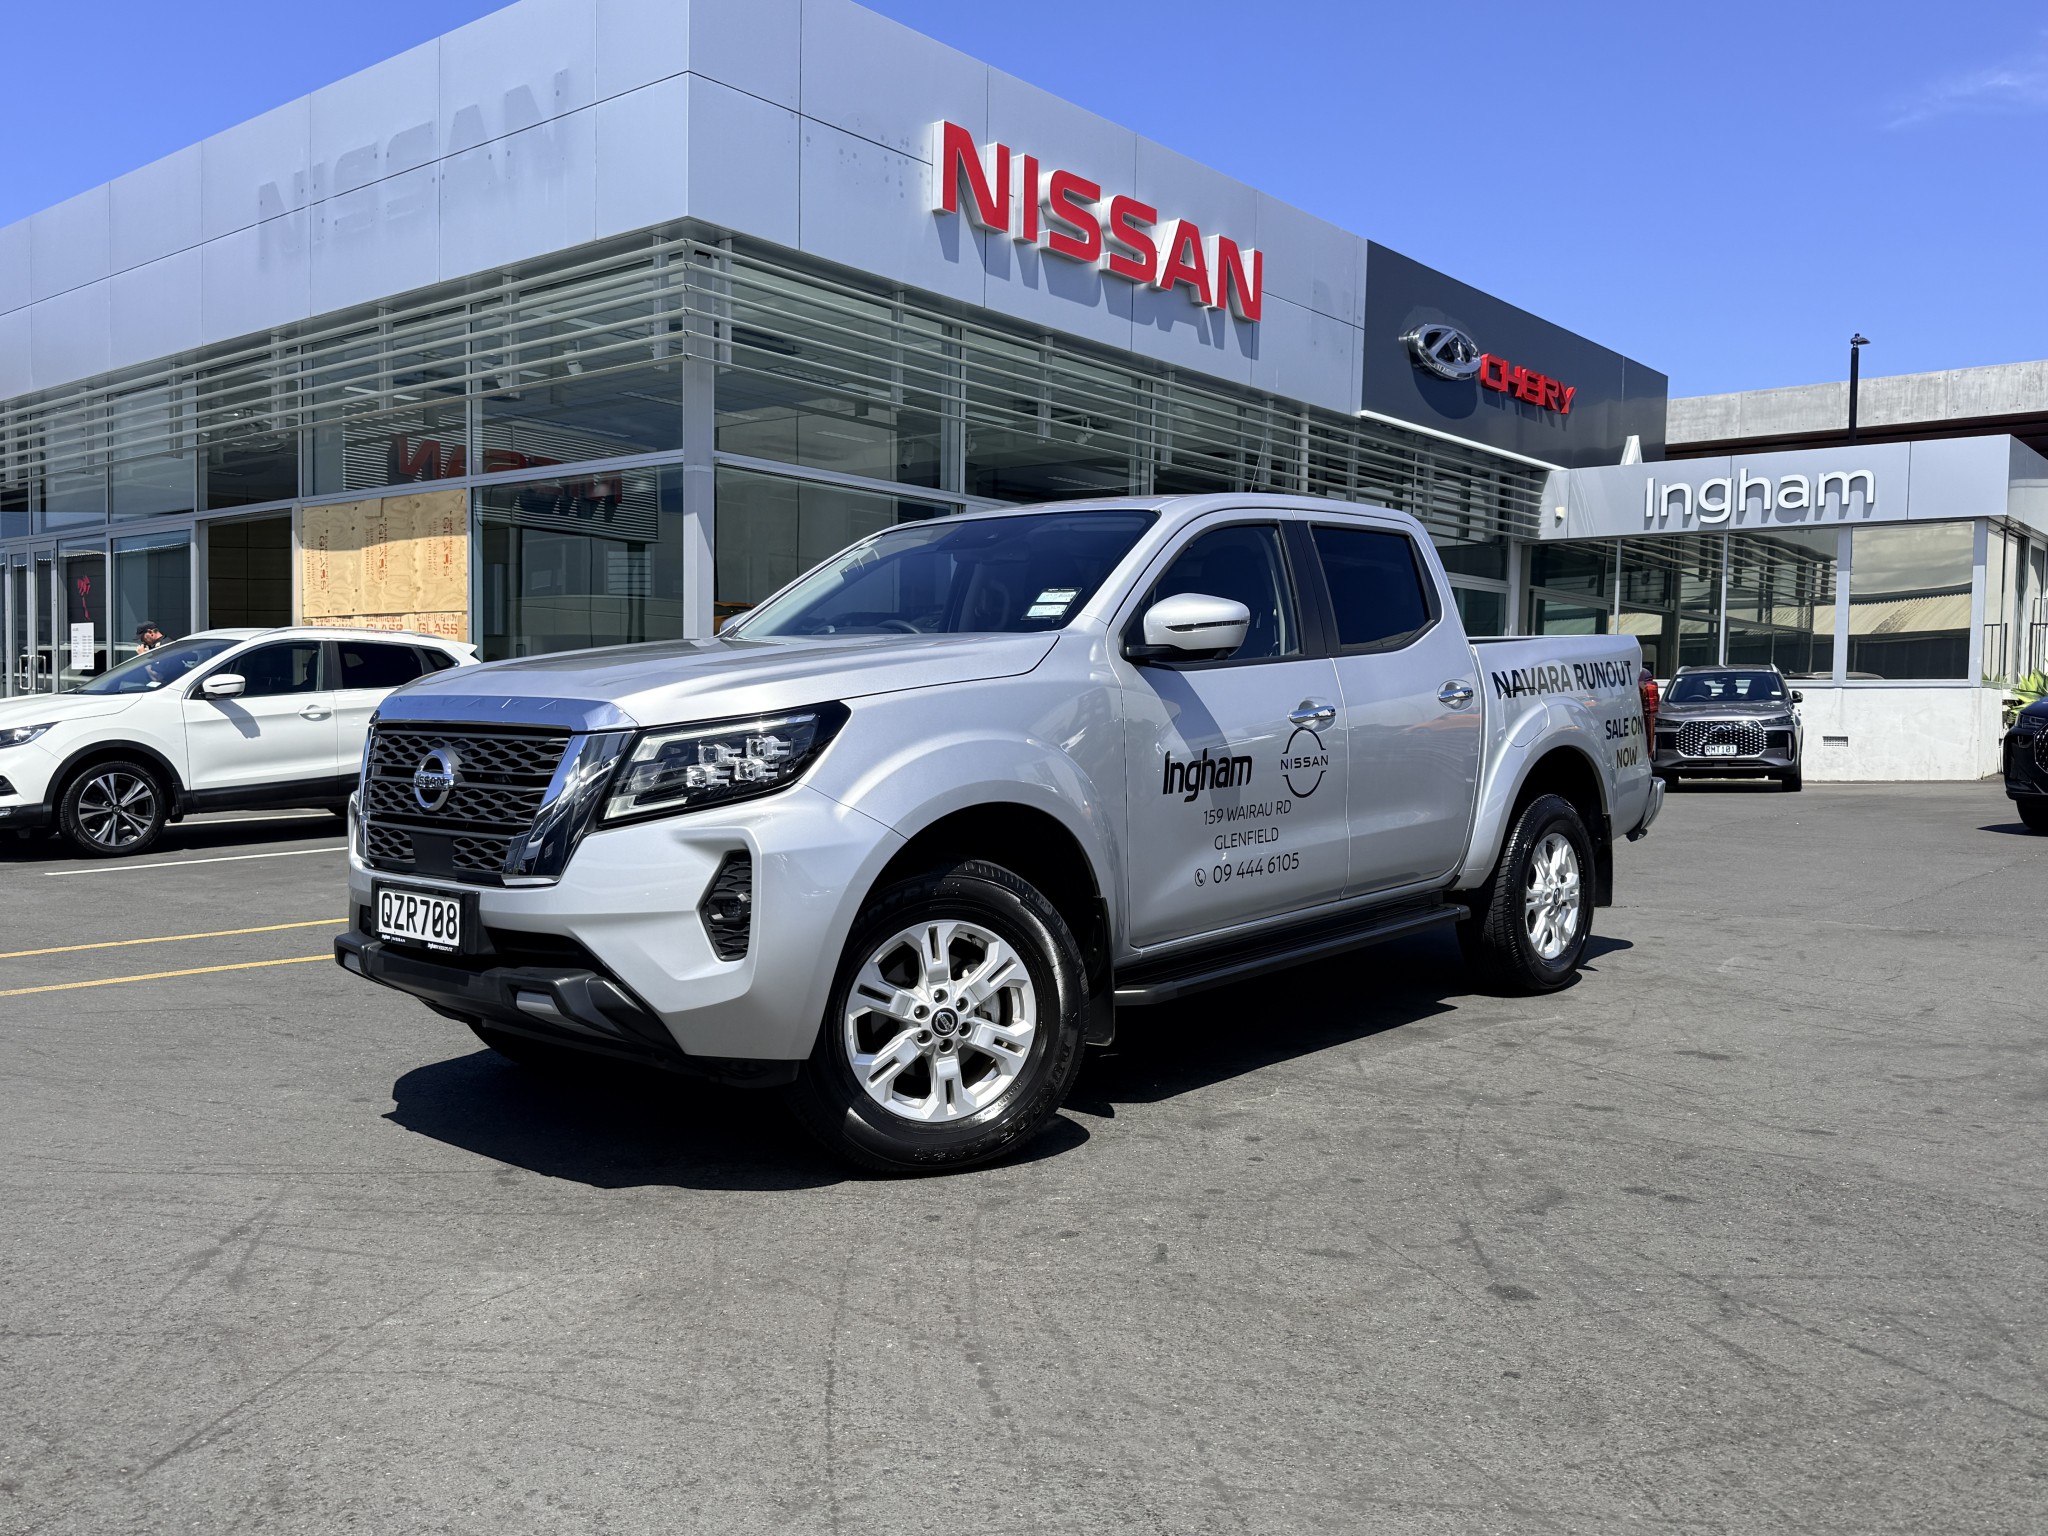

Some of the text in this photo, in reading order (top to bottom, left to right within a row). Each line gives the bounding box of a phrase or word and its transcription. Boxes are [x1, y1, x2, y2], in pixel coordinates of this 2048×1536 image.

[933, 120, 1262, 322] NISSAN
[1480, 353, 1577, 414] CHERY
[1645, 468, 1875, 524] Ingham
[418, 623, 458, 634] GLASS
[1491, 660, 1632, 700] NAVARA RUNOUT
[1605, 717, 1644, 740] SALE ON
[1280, 754, 1329, 770] NISSAN
[1616, 746, 1638, 768] NOW
[1162, 748, 1253, 803] Ingham
[1203, 799, 1292, 825] 159 WAIRAU RD
[1214, 827, 1279, 851] GLENFIELD
[1213, 852, 1300, 884] 09 444 6105
[381, 892, 459, 941] QZR708
